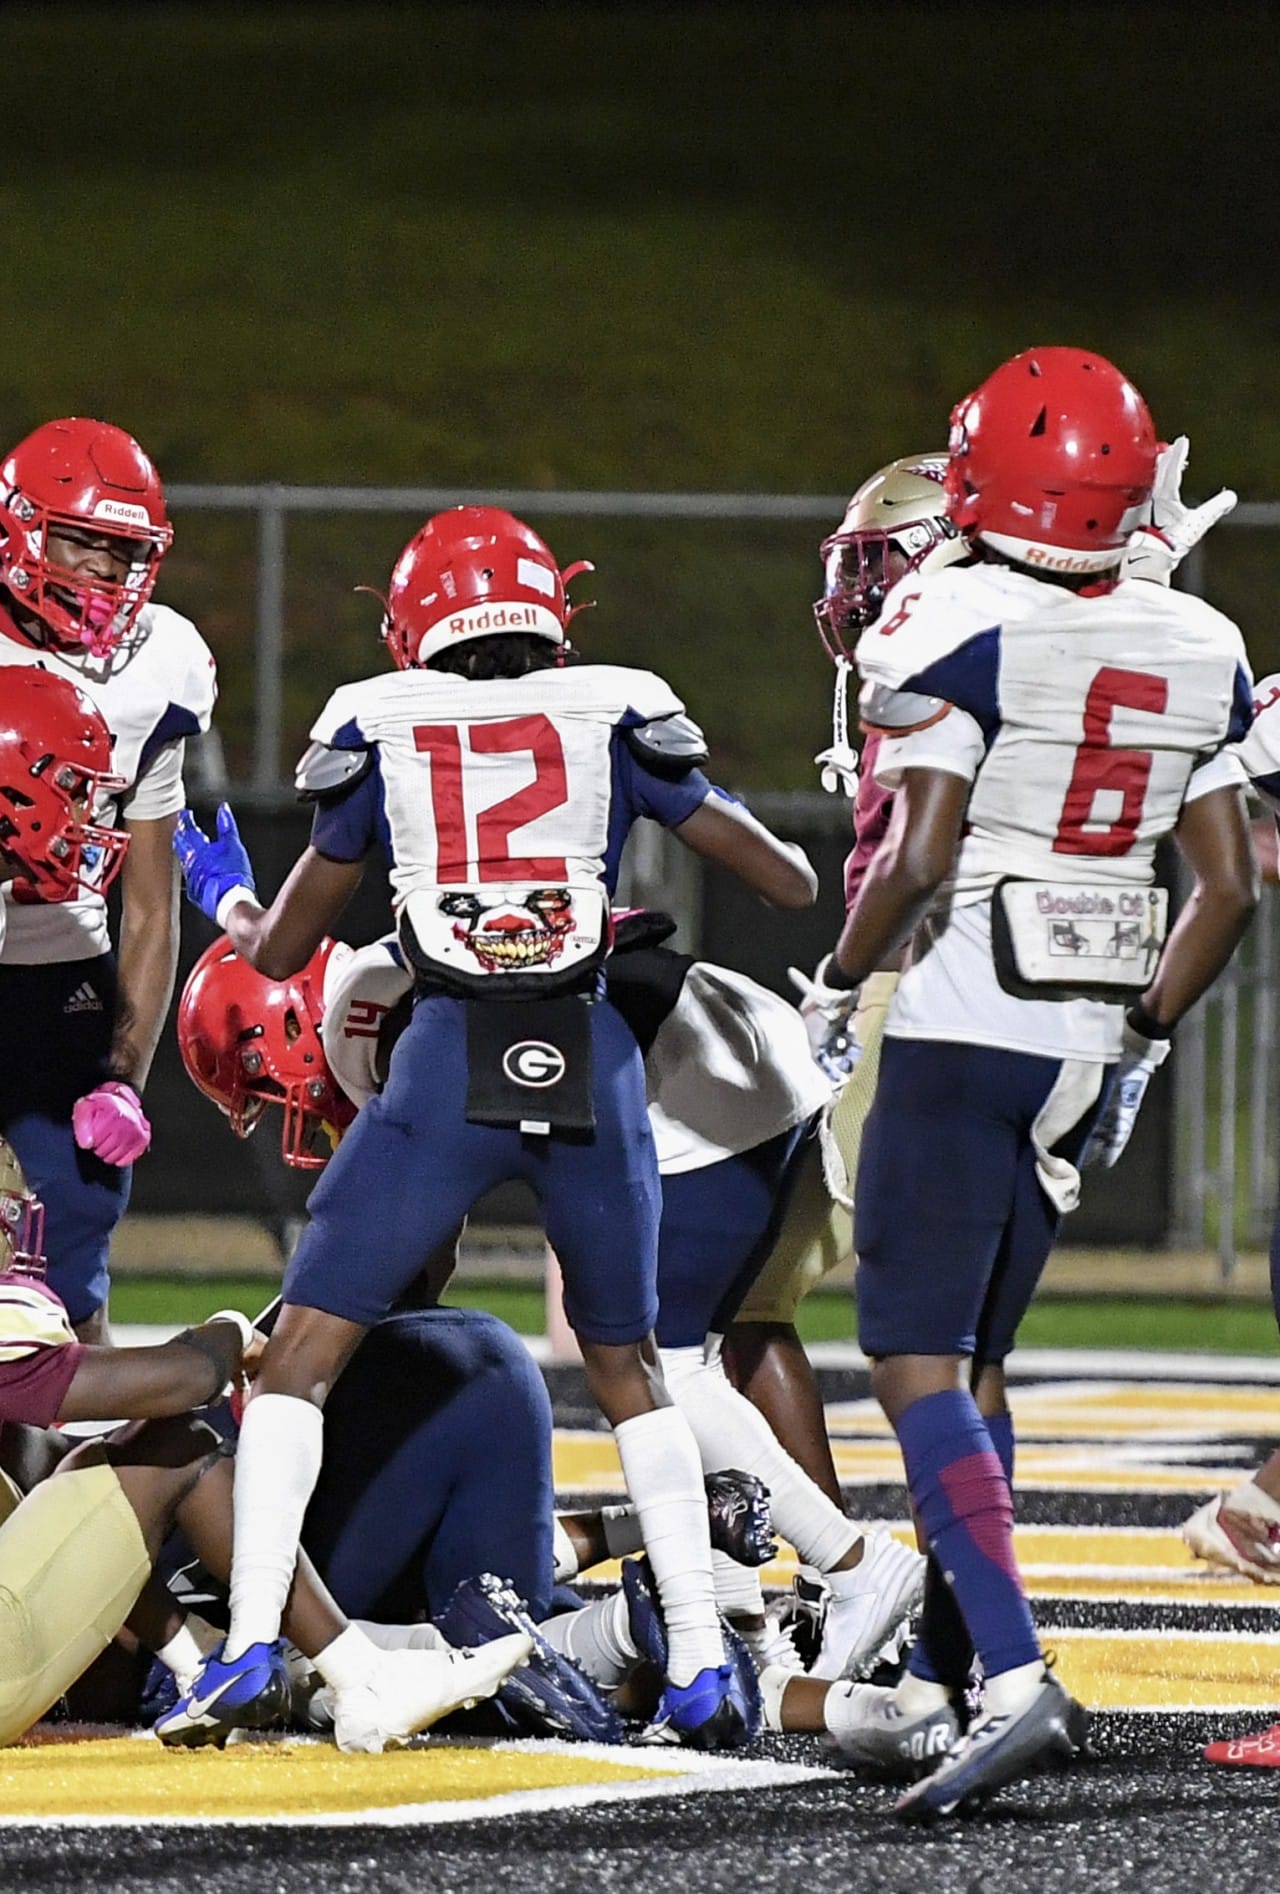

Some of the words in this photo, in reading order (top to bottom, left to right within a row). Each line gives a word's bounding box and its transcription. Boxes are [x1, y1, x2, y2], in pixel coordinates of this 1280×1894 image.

[104, 503, 144, 520] Riddell
[449, 608, 538, 635] Riddell
[879, 592, 922, 636] 6
[1051, 666, 1169, 858] 6
[412, 712, 569, 885] 12
[63, 1000, 104, 1013] adidas
[344, 1000, 390, 1039] 14
